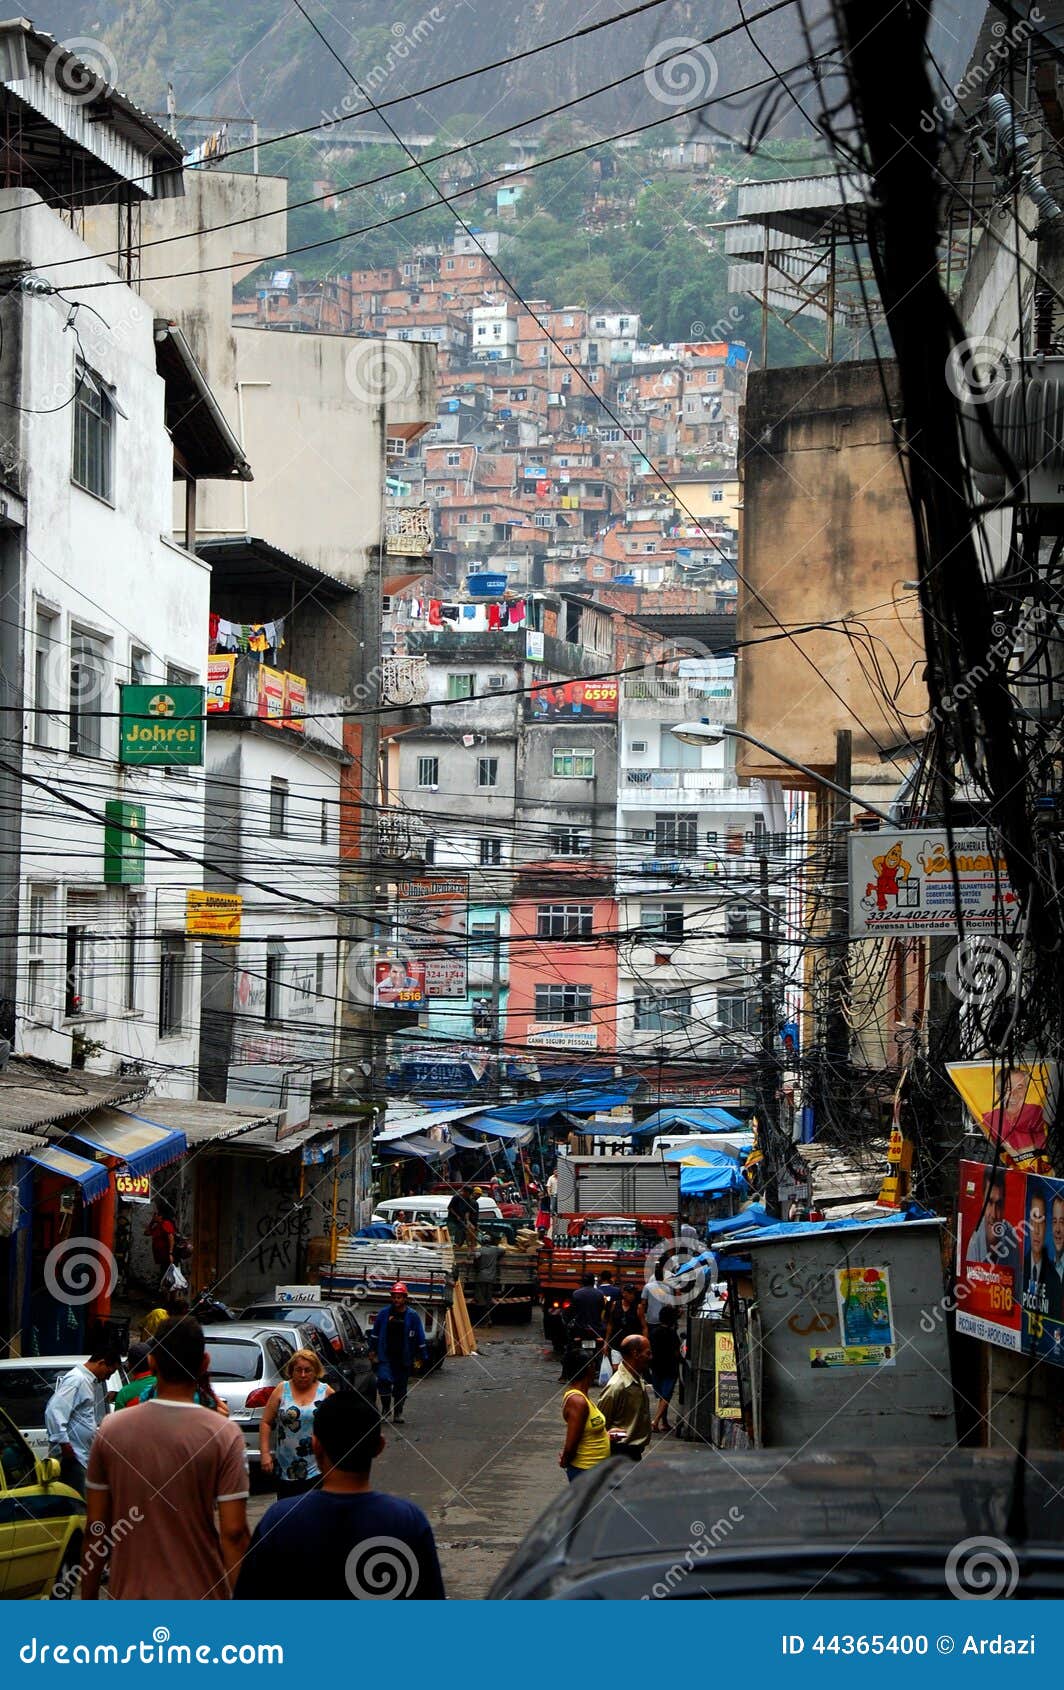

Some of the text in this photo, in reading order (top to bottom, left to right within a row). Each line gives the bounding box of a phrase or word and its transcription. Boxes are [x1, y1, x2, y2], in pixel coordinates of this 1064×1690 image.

[585, 689, 617, 700] 6599
[126, 724, 196, 742] Johrei
[866, 922, 904, 930] Travessa
[400, 991, 421, 1001] 1516
[988, 1284, 1012, 1311] 1516
